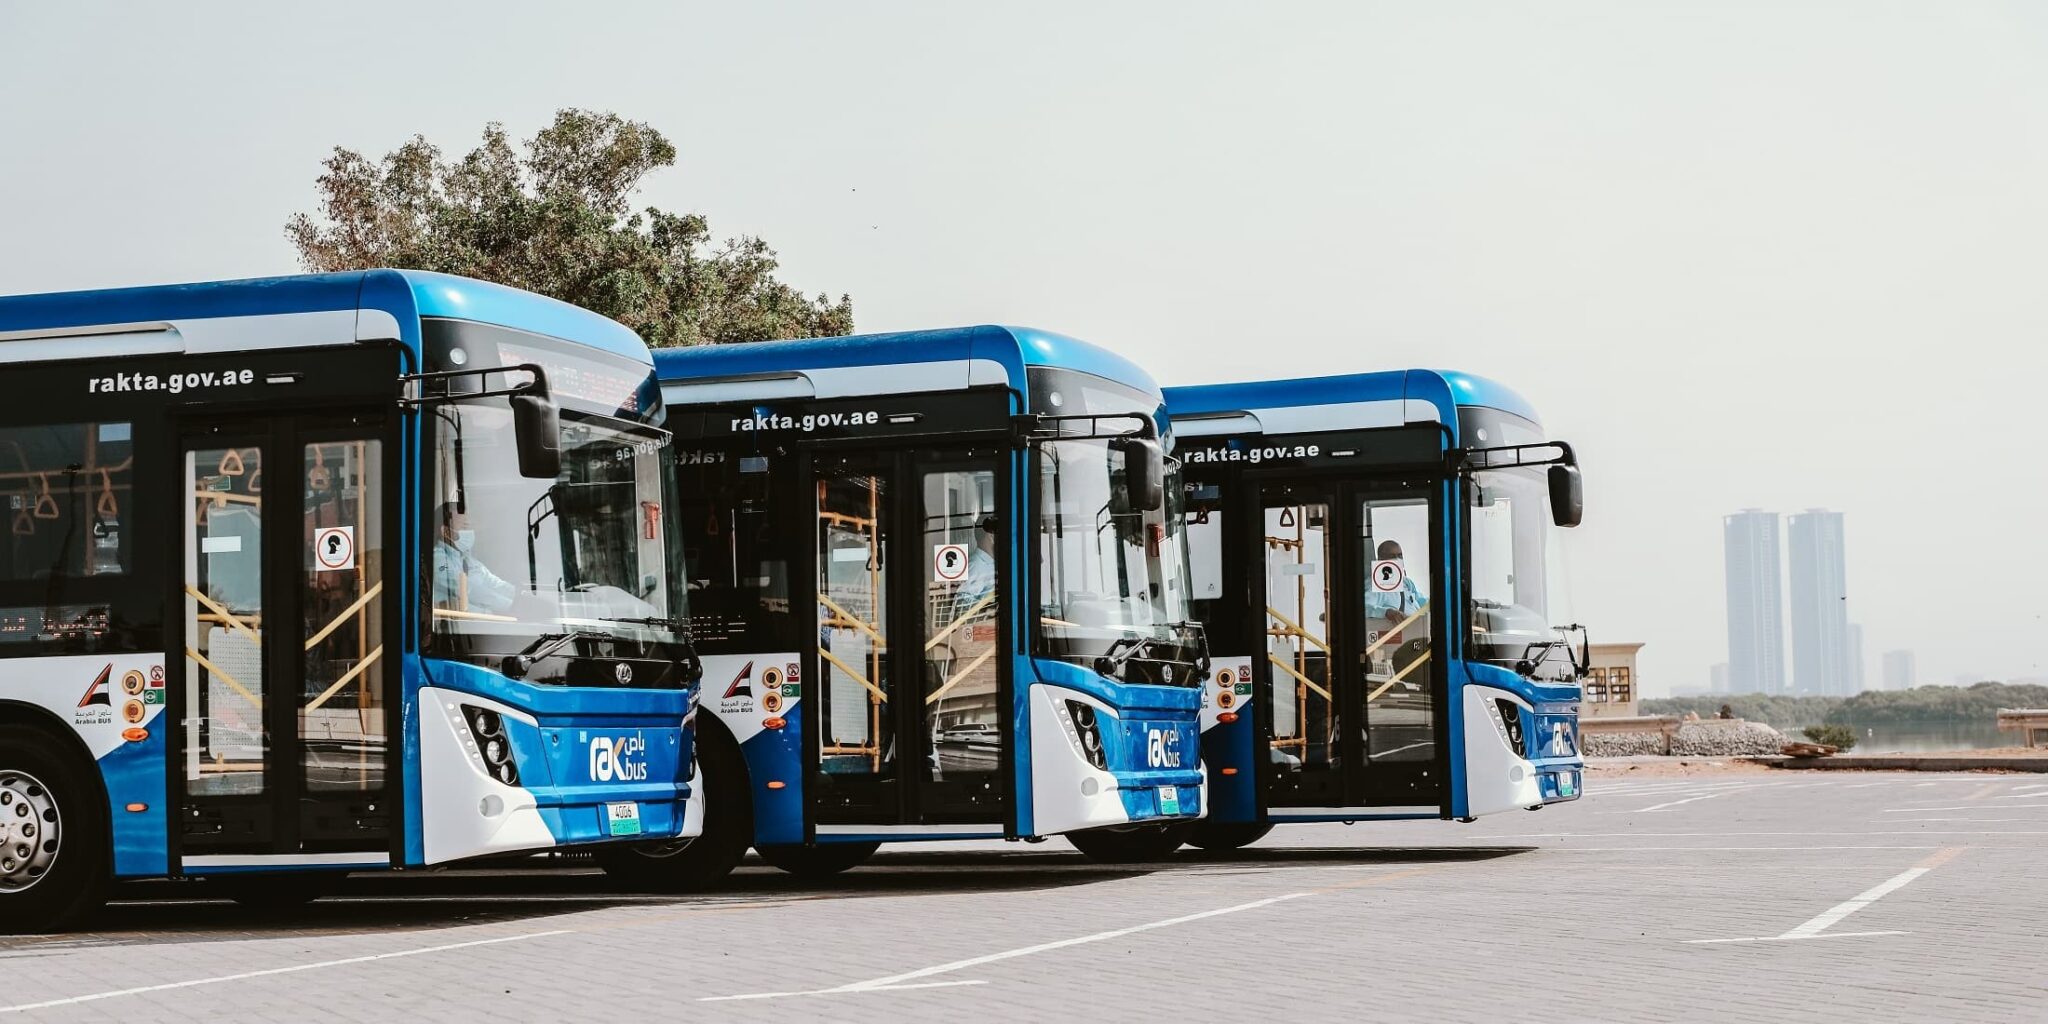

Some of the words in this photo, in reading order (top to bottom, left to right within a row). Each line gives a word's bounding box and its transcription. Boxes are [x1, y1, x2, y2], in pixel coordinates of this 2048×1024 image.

[89, 369, 254, 393] rakta.gov.ae
[731, 410, 879, 432] rakta.gov.ae
[1184, 445, 1320, 463] rakta.gov.ae
[625, 730, 645, 756] باص
[625, 757, 647, 780] bus
[1168, 748, 1180, 767] bus
